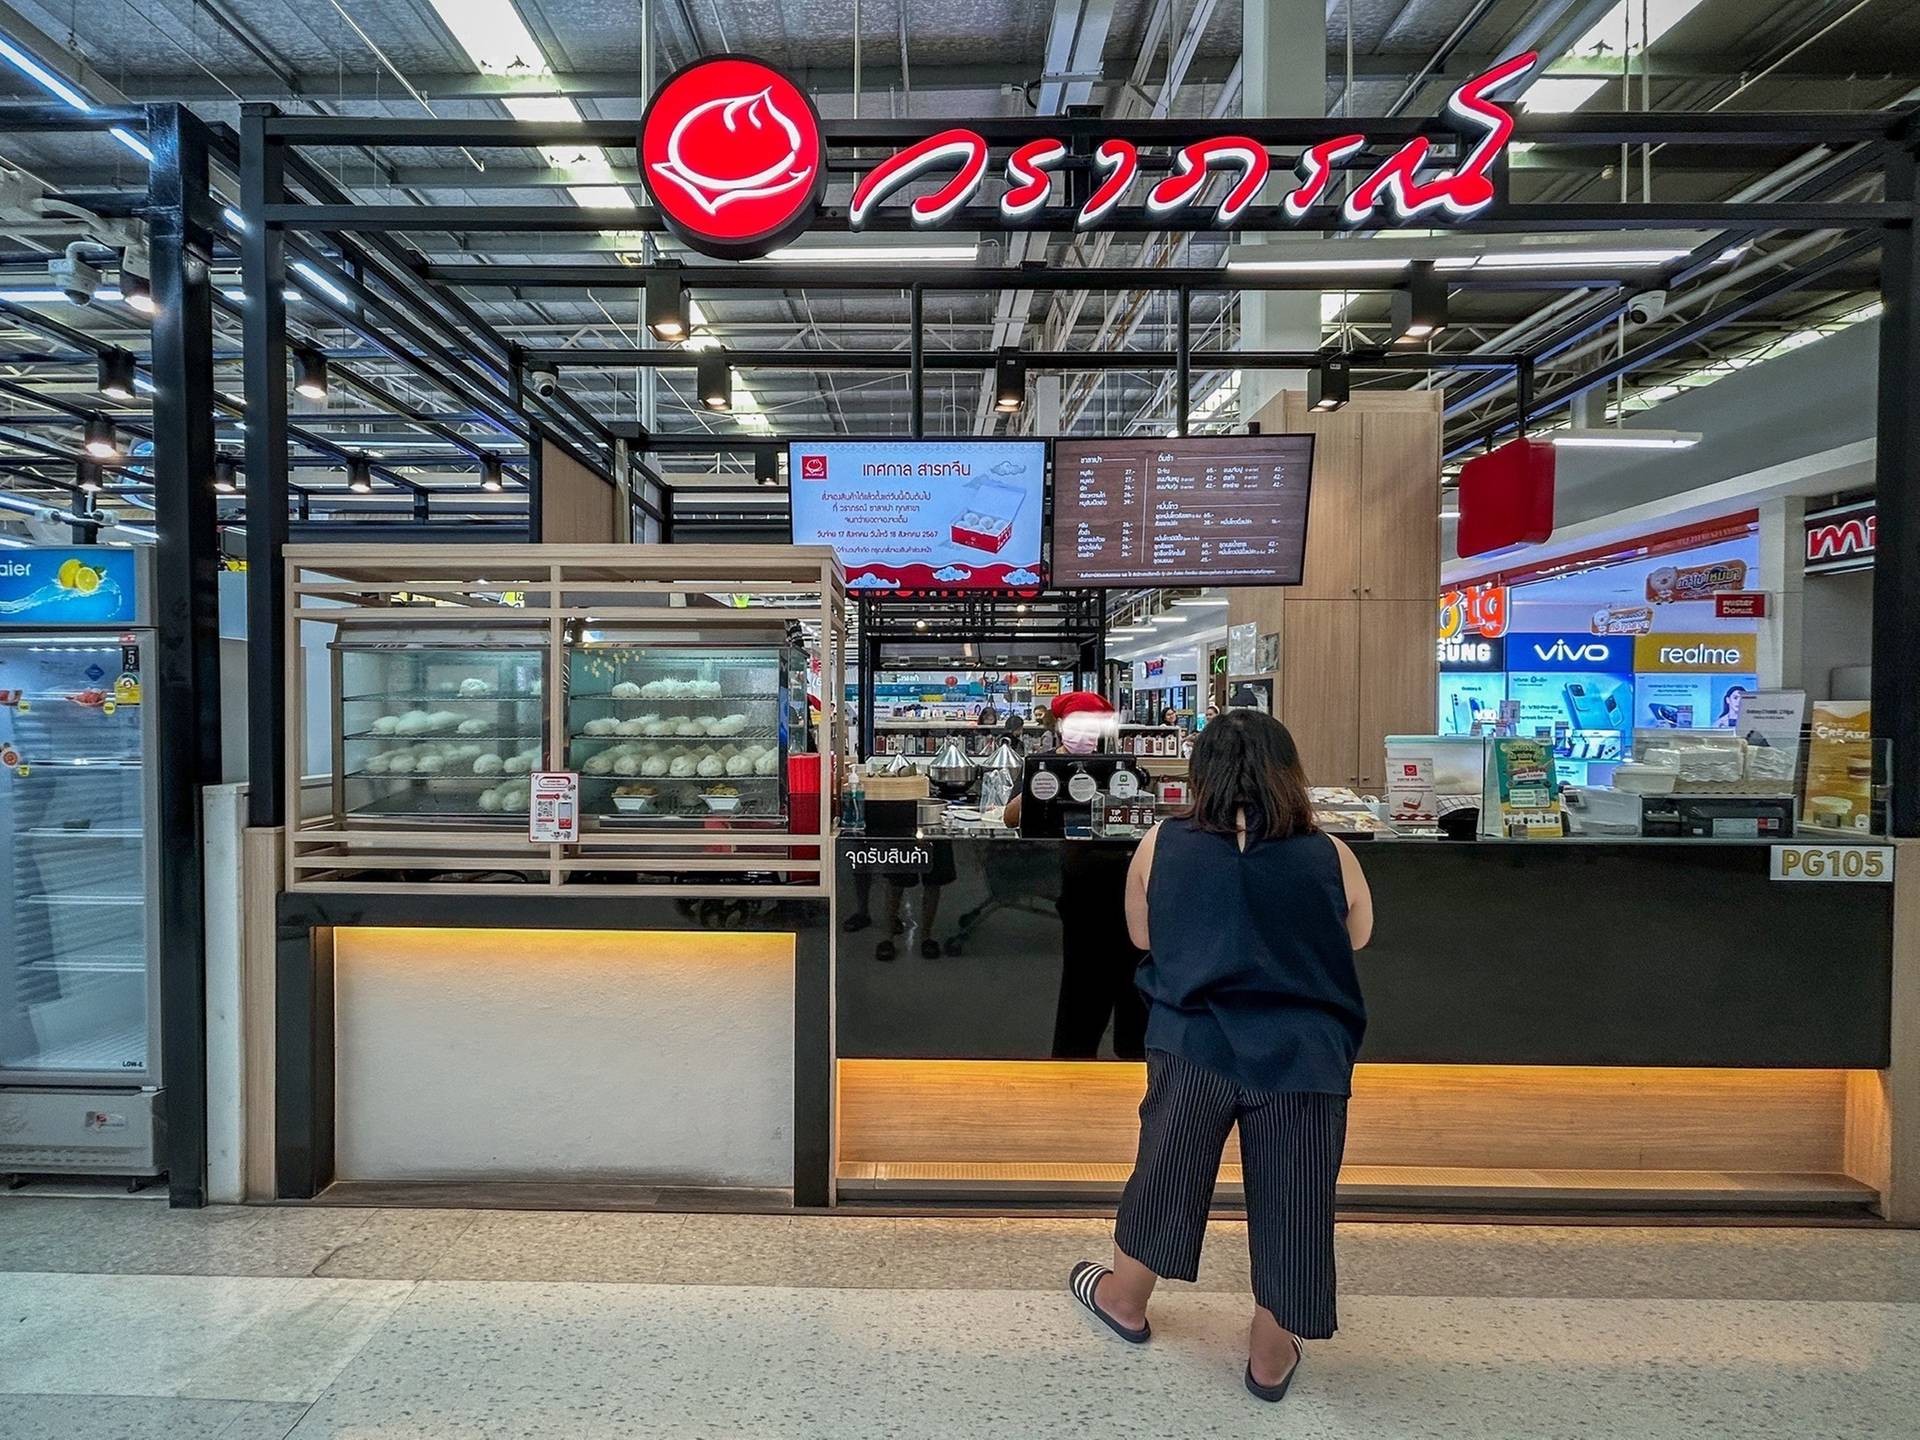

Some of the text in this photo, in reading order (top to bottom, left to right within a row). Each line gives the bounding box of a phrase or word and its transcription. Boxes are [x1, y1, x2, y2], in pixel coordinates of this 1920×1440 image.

[850, 50, 1540, 230] วราภรณ์
[863, 460, 971, 477] เทศกาล สารทจีน
[1533, 639, 1610, 662] vivo
[1659, 643, 1740, 664] realme
[845, 846, 929, 869] จุดรับสินค้า
[1781, 849, 1884, 877] PG105
